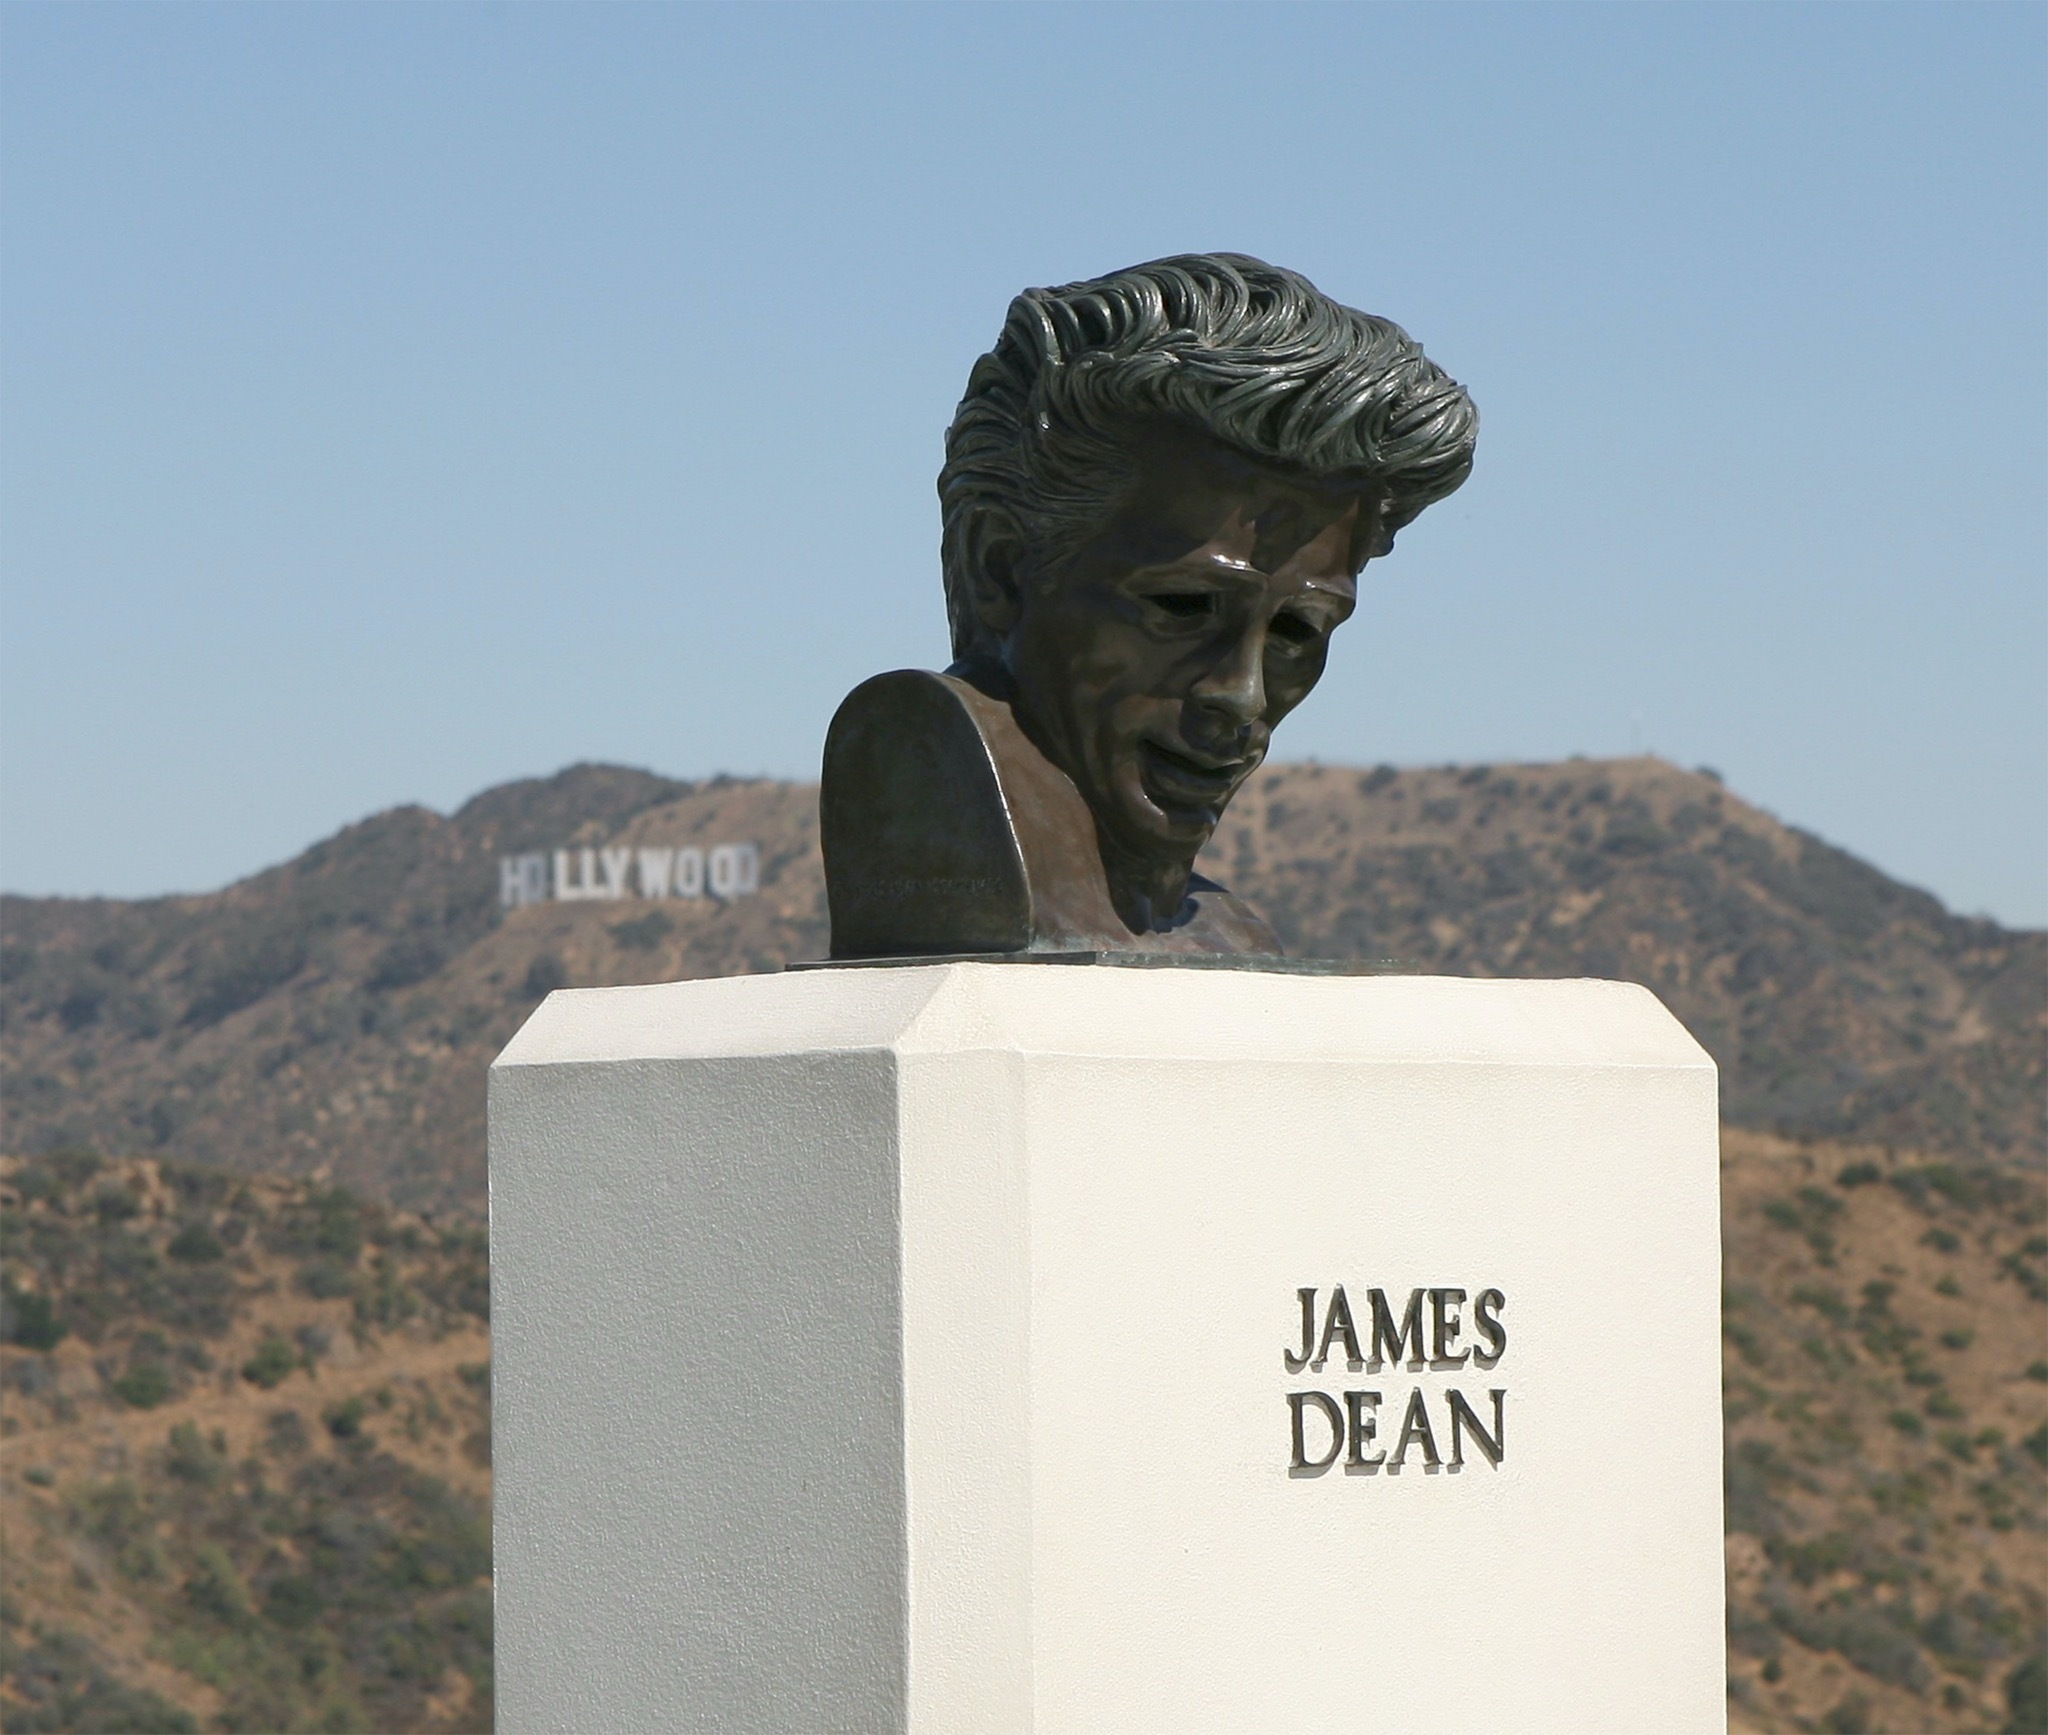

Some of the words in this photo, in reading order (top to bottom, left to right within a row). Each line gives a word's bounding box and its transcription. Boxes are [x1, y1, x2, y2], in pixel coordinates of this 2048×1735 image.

[499, 842, 759, 906] HOLLYWOOD
[1284, 1284, 1507, 1372] JAMES
[1286, 1387, 1507, 1477] DEAN
